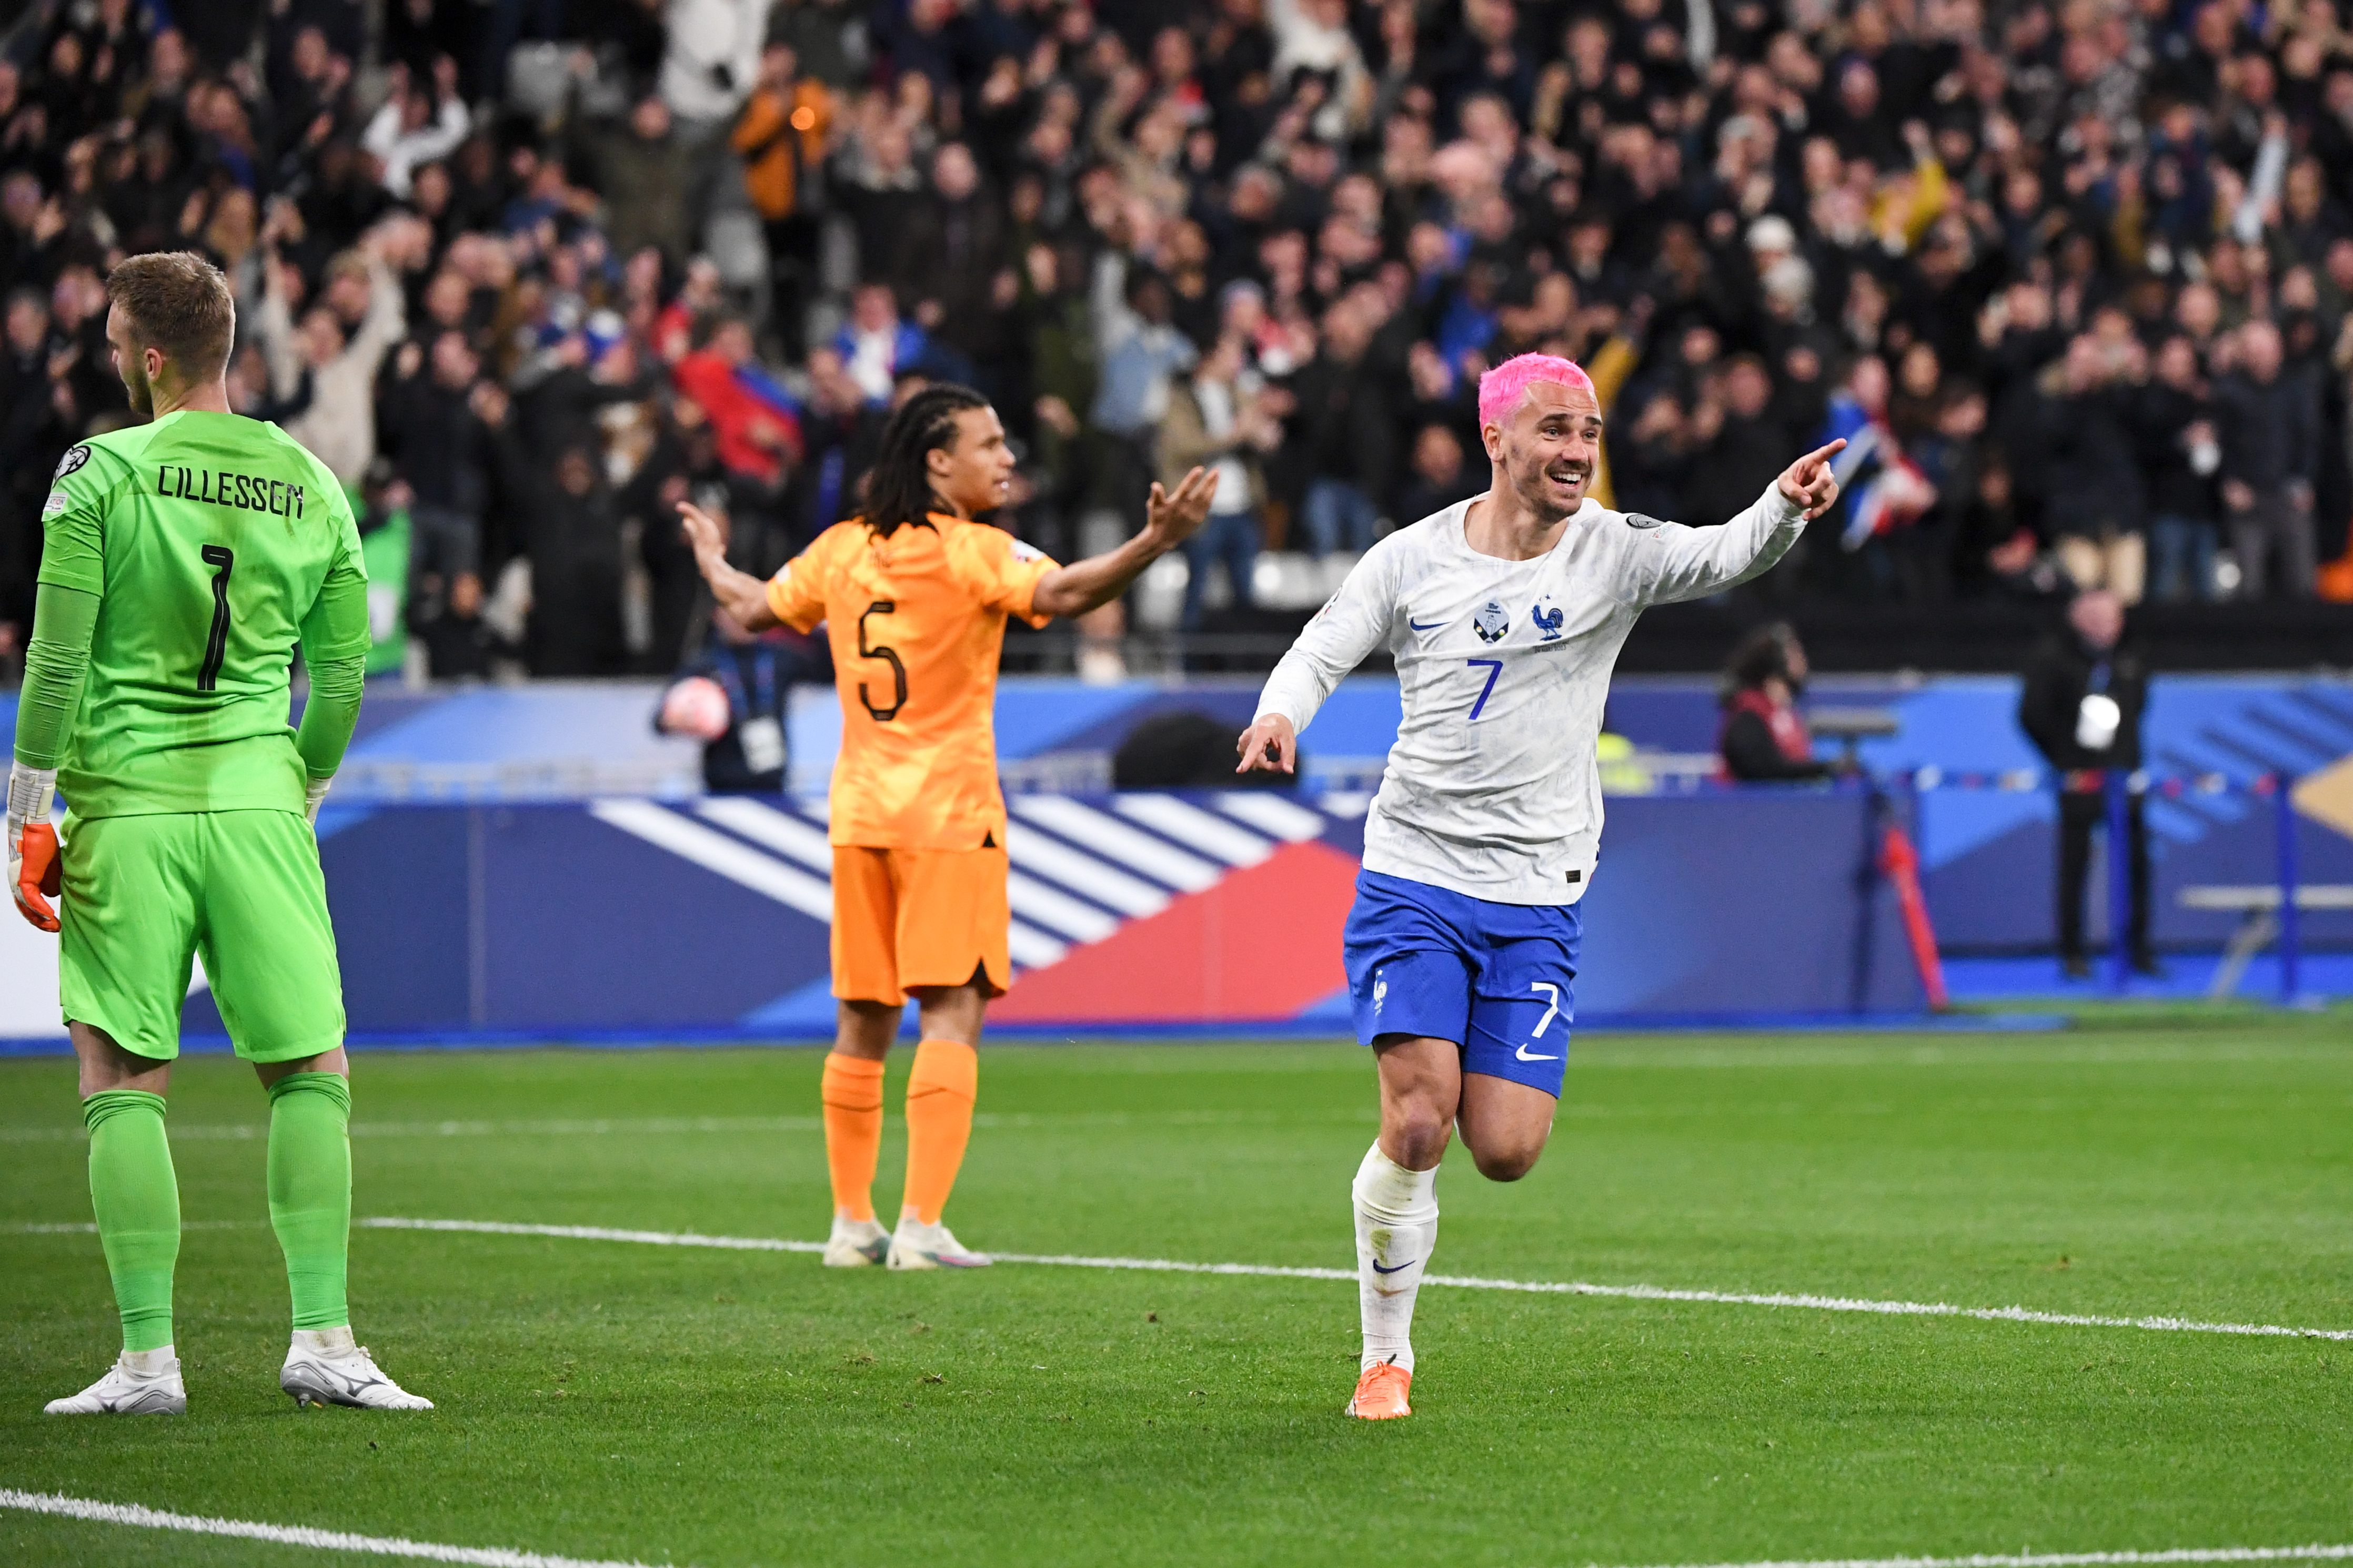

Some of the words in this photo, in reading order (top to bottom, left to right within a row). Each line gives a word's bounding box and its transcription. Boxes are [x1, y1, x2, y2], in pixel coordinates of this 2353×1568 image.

[158, 466, 304, 519] CILLESSEN
[858, 602, 907, 721] 5
[1467, 659, 1503, 720] 7
[1532, 982, 1558, 1038] 7
